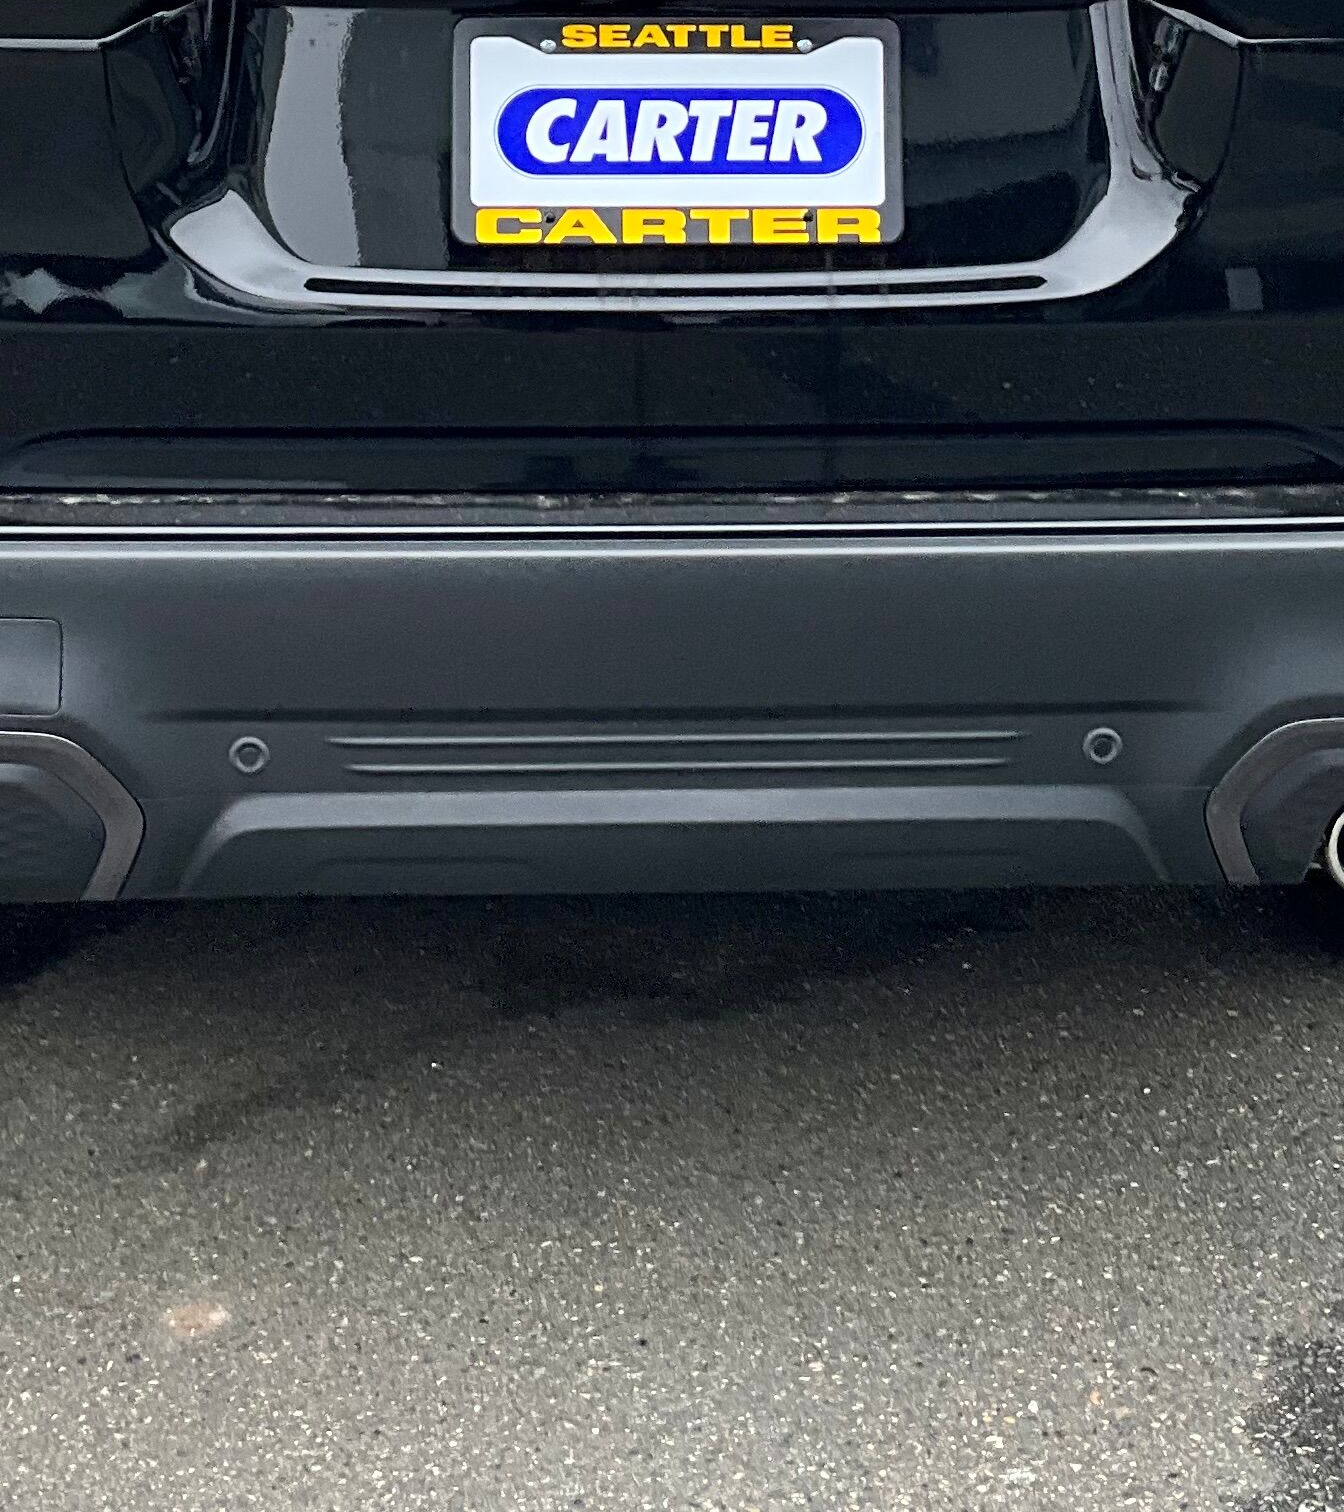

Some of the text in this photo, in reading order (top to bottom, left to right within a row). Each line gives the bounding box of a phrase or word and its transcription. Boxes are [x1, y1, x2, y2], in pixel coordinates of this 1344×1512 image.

[561, 24, 794, 49] SEATTLE
[525, 98, 828, 163] CARTER
[475, 208, 882, 244] CARTER
